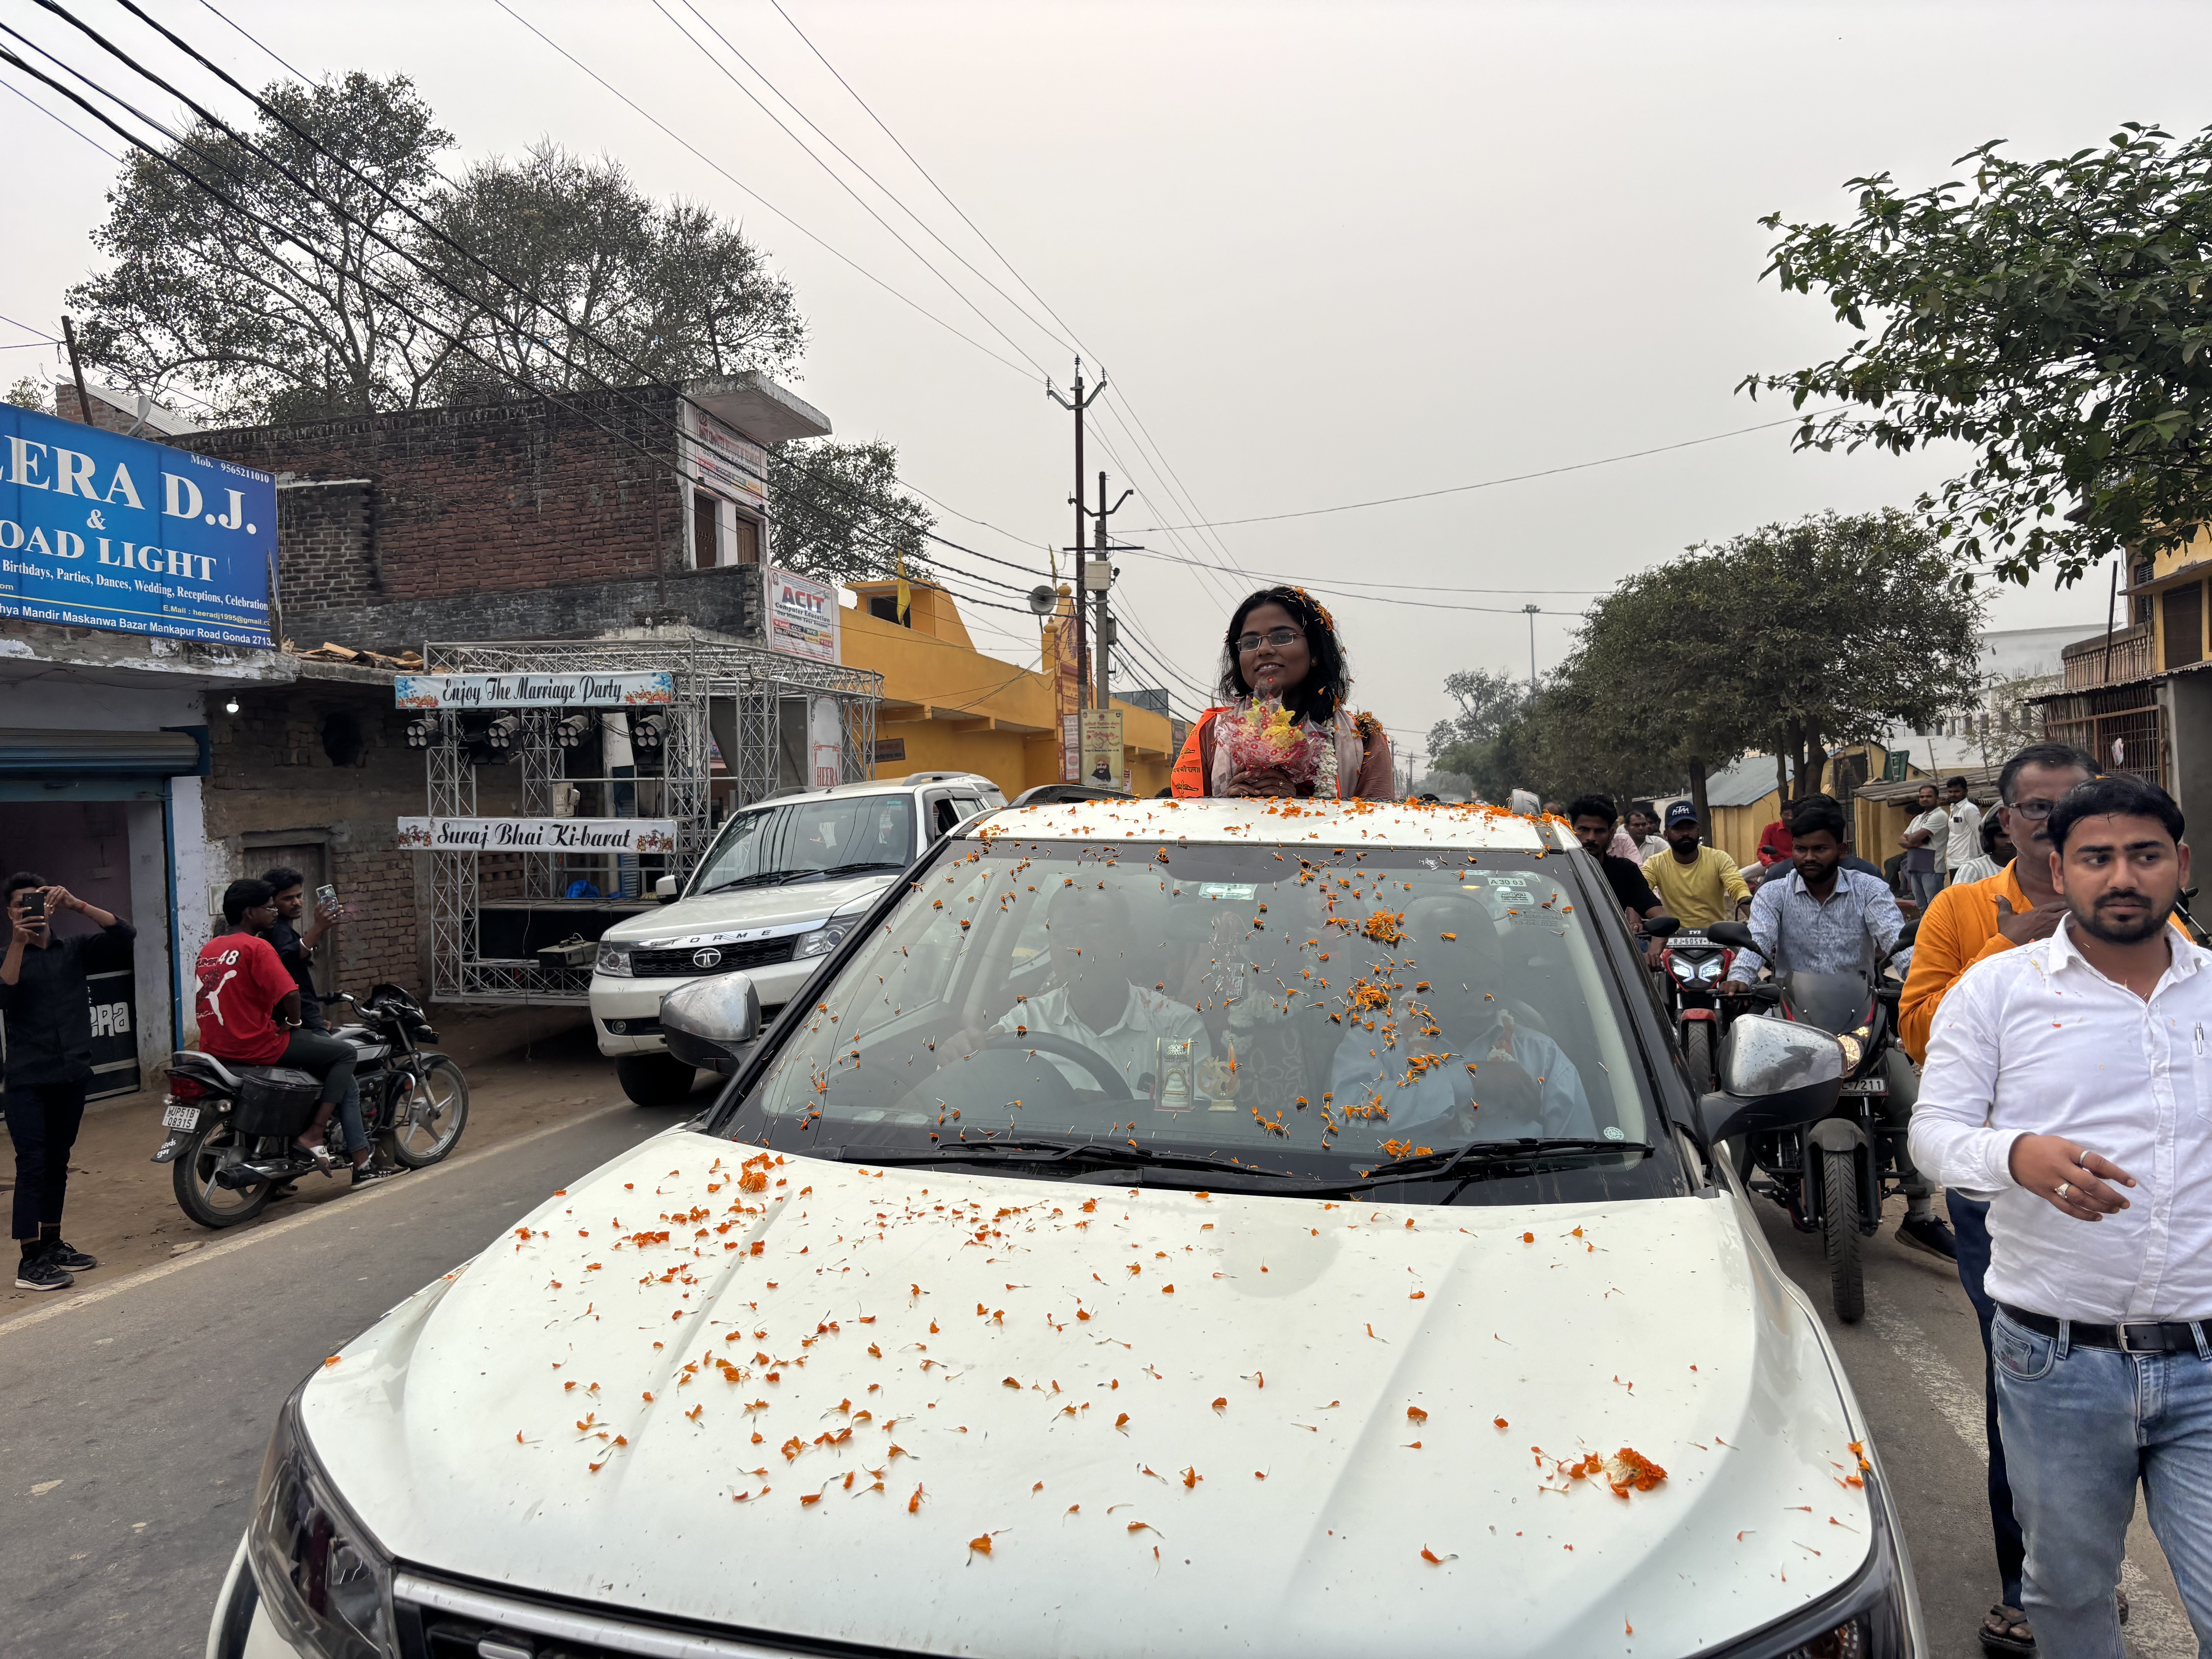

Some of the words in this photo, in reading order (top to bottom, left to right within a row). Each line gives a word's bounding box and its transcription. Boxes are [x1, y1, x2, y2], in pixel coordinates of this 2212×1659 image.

[191, 454, 213, 468] Mob.
[221, 463, 270, 483] 9565211010
[0, 435, 146, 510] ERA
[161, 472, 257, 535] D.J.
[86, 509, 106, 530] &
[96, 537, 217, 582] LIGHT
[3, 559, 53, 580] Birthdays,
[57, 568, 93, 587] Parties,
[96, 574, 132, 592] Dances,
[134, 579, 174, 598] Wedding,
[177, 586, 223, 606] Receptions,
[163, 605, 186, 614] E.Mail
[782, 586, 824, 613] ACIT
[775, 602, 804, 615] Computer
[805, 611, 830, 623] Education
[22, 606, 60, 620] Mandir
[63, 611, 117, 627] Maskanwa
[120, 618, 147, 630] Bazar
[150, 622, 195, 637] Mankapur
[198, 628, 220, 639] Road
[223, 631, 251, 644] Gonda
[443, 678, 482, 706] Enjoy
[486, 677, 512, 700] The
[514, 677, 576, 704] Marriage
[579, 675, 622, 703] Party
[817, 767, 838, 787] HEERA
[1672, 806, 1689, 816] KTM
[437, 822, 489, 849] Suraj
[495, 823, 543, 845] Bhai
[548, 824, 631, 848] Ki-barat
[649, 930, 772, 946] STORME
[218, 950, 240, 965] 48
[168, 1117, 192, 1128] 08315
[171, 1107, 196, 1118] UP51B
